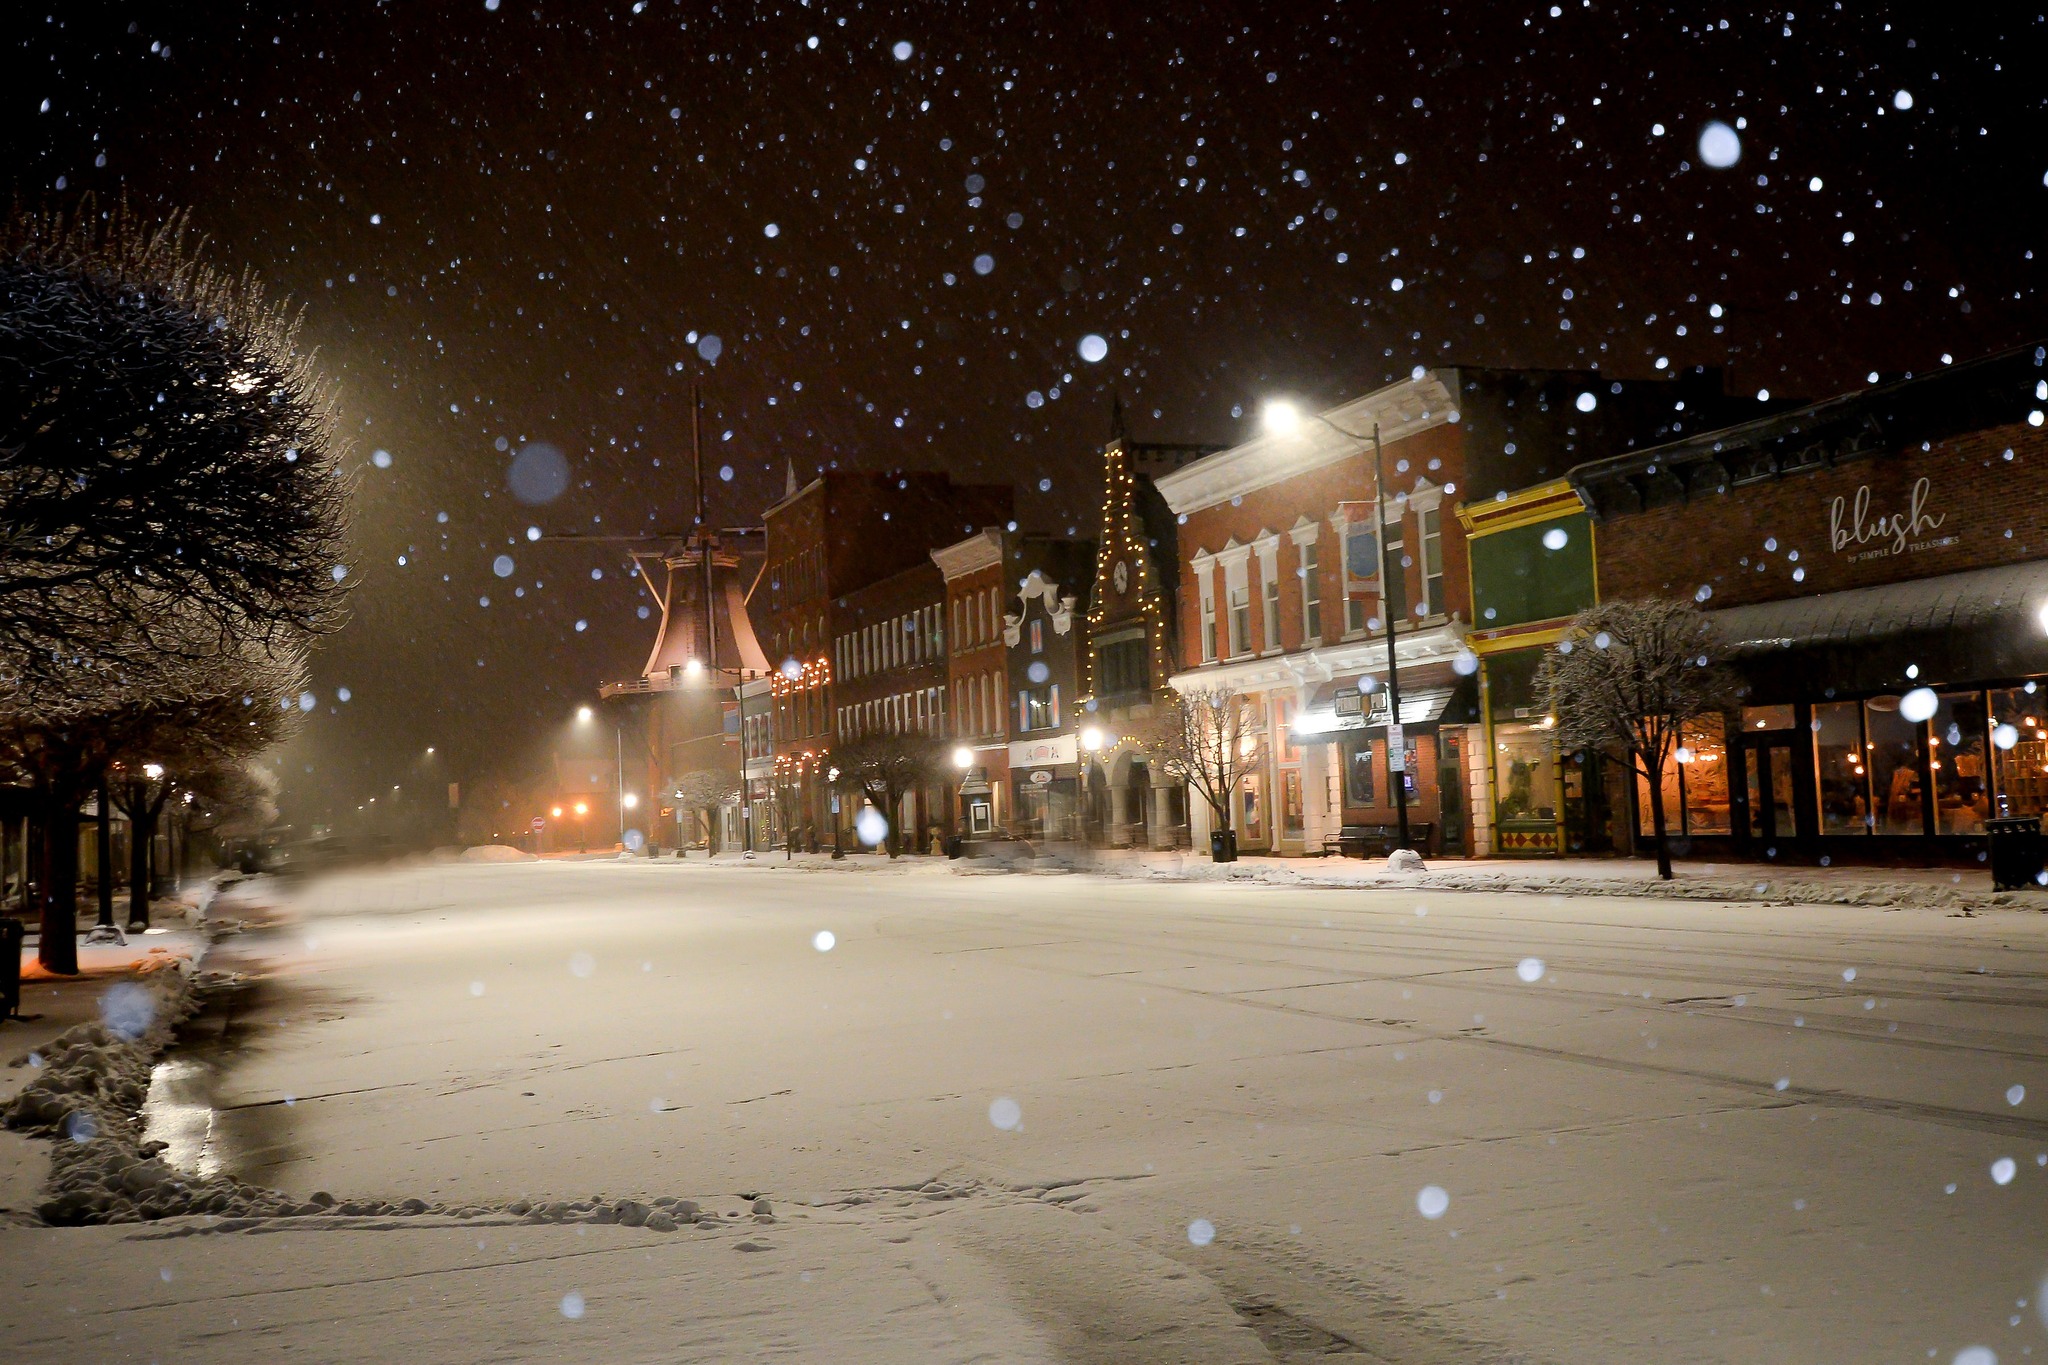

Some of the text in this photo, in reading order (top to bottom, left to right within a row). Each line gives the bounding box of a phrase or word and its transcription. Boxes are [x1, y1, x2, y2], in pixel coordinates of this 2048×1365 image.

[1831, 477, 1946, 554] blush
[1859, 548, 1889, 561] SIMPLE
[1908, 536, 1960, 553] TREASUES
